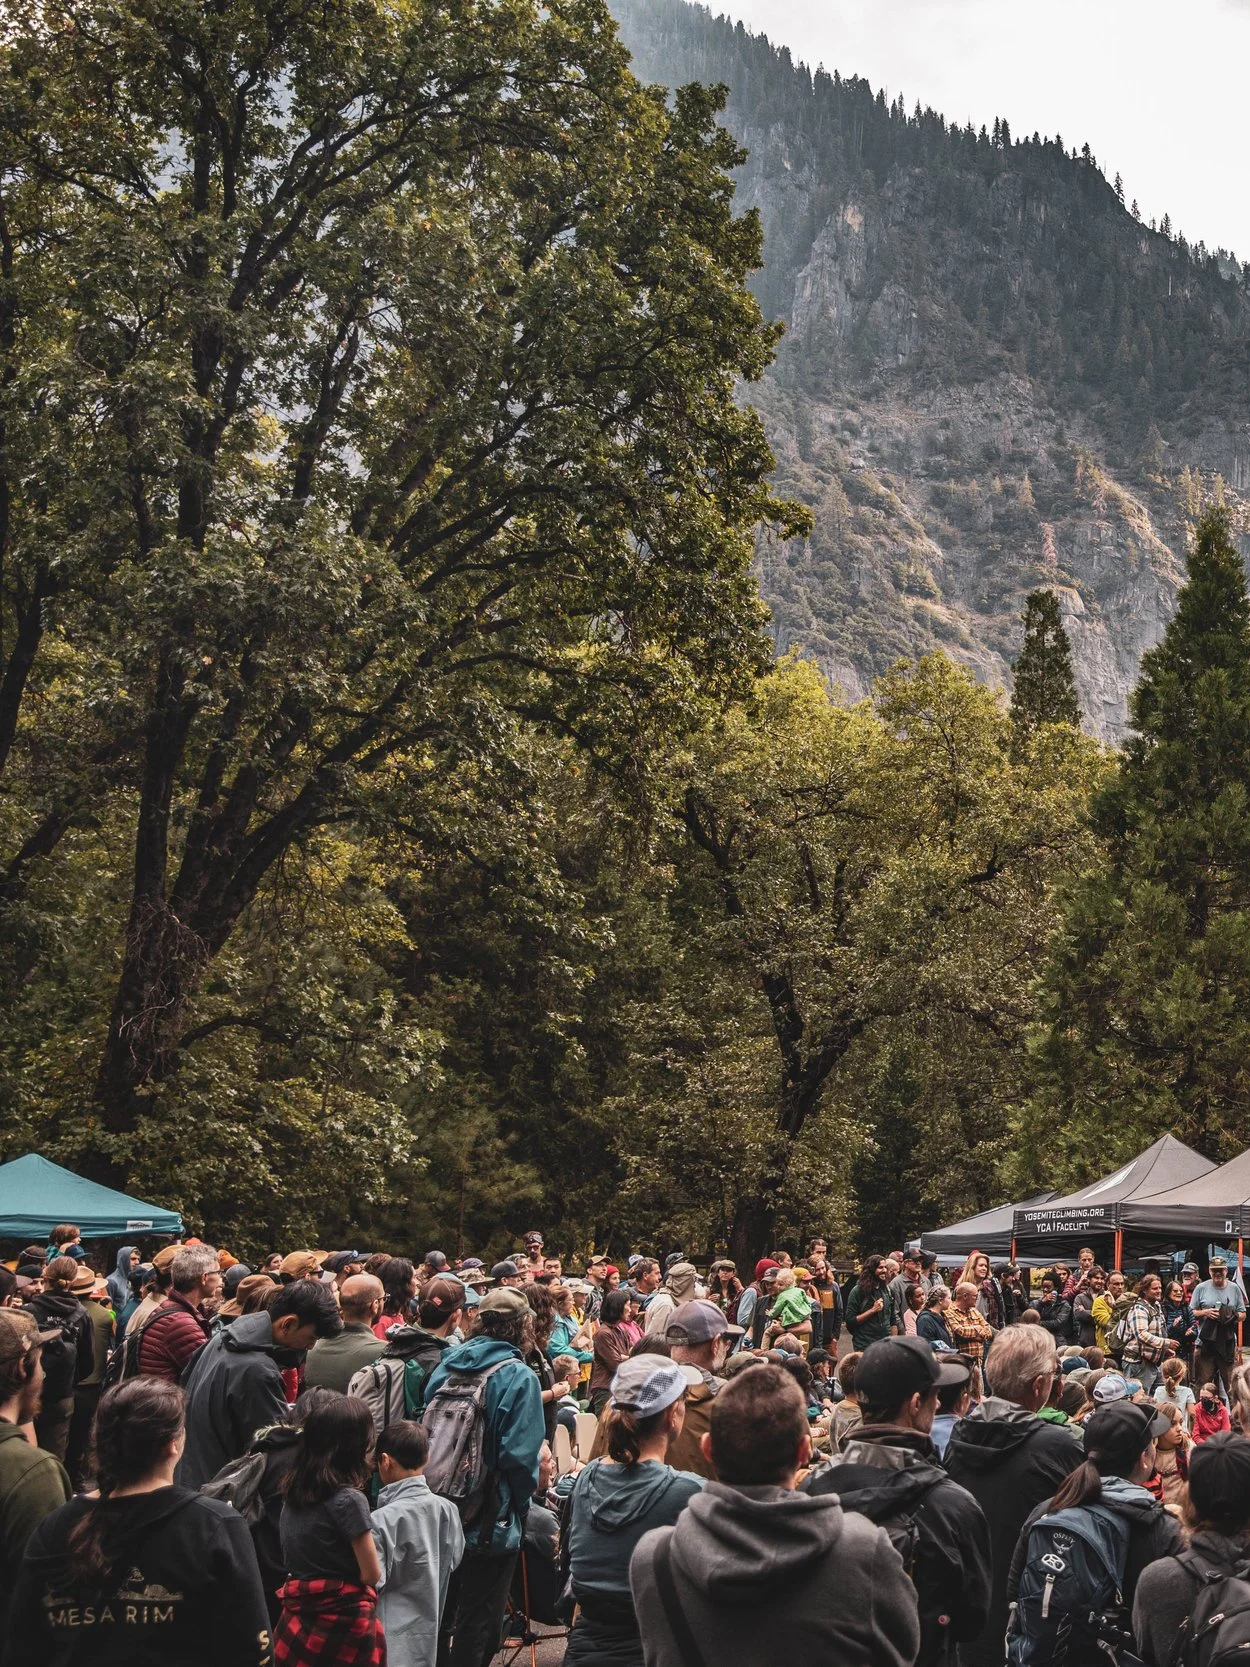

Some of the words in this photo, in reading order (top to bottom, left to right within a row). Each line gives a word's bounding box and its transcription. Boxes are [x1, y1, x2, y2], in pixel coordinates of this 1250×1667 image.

[1024, 1208, 1105, 1221] YOSEMITECLIMBING.ORG
[1036, 1223, 1051, 1233] YCA
[48, 1606, 115, 1627] MESA
[125, 1605, 174, 1624] RIM
